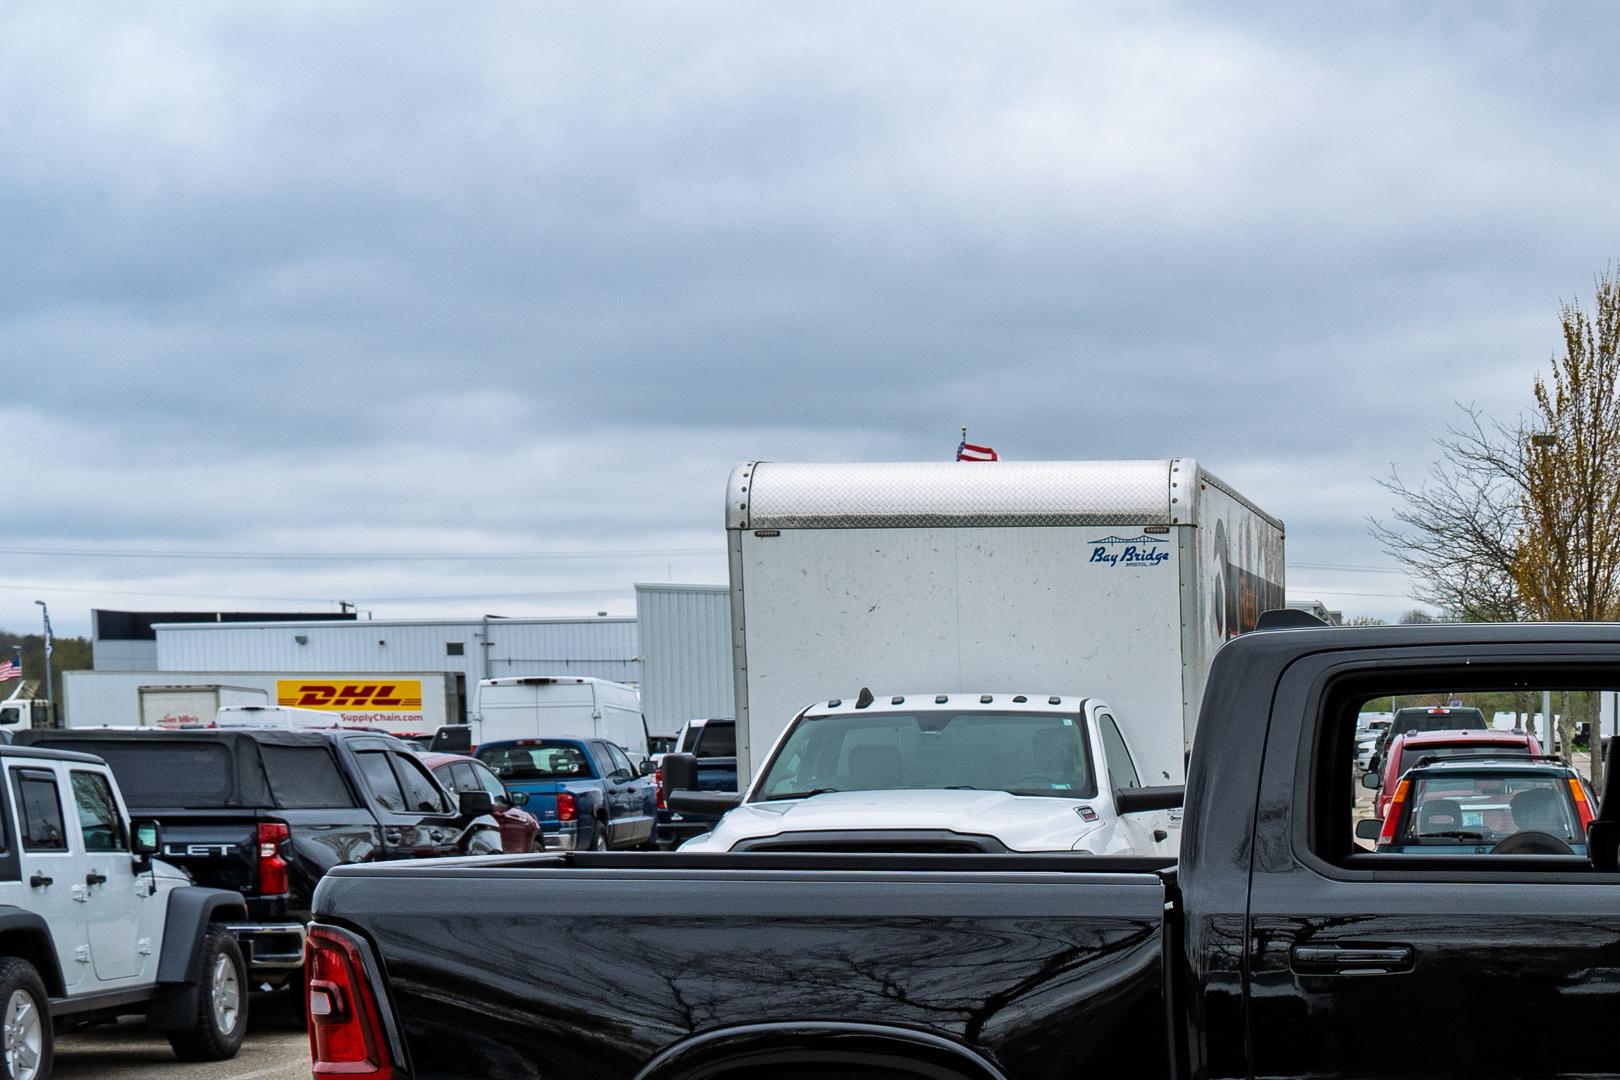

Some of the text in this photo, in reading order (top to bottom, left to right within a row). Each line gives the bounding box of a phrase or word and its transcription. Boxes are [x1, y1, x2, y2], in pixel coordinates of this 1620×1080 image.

[1089, 545, 1170, 567] Bay Bridge
[298, 685, 402, 706] DHL
[340, 713, 423, 722] SupplyChain.com
